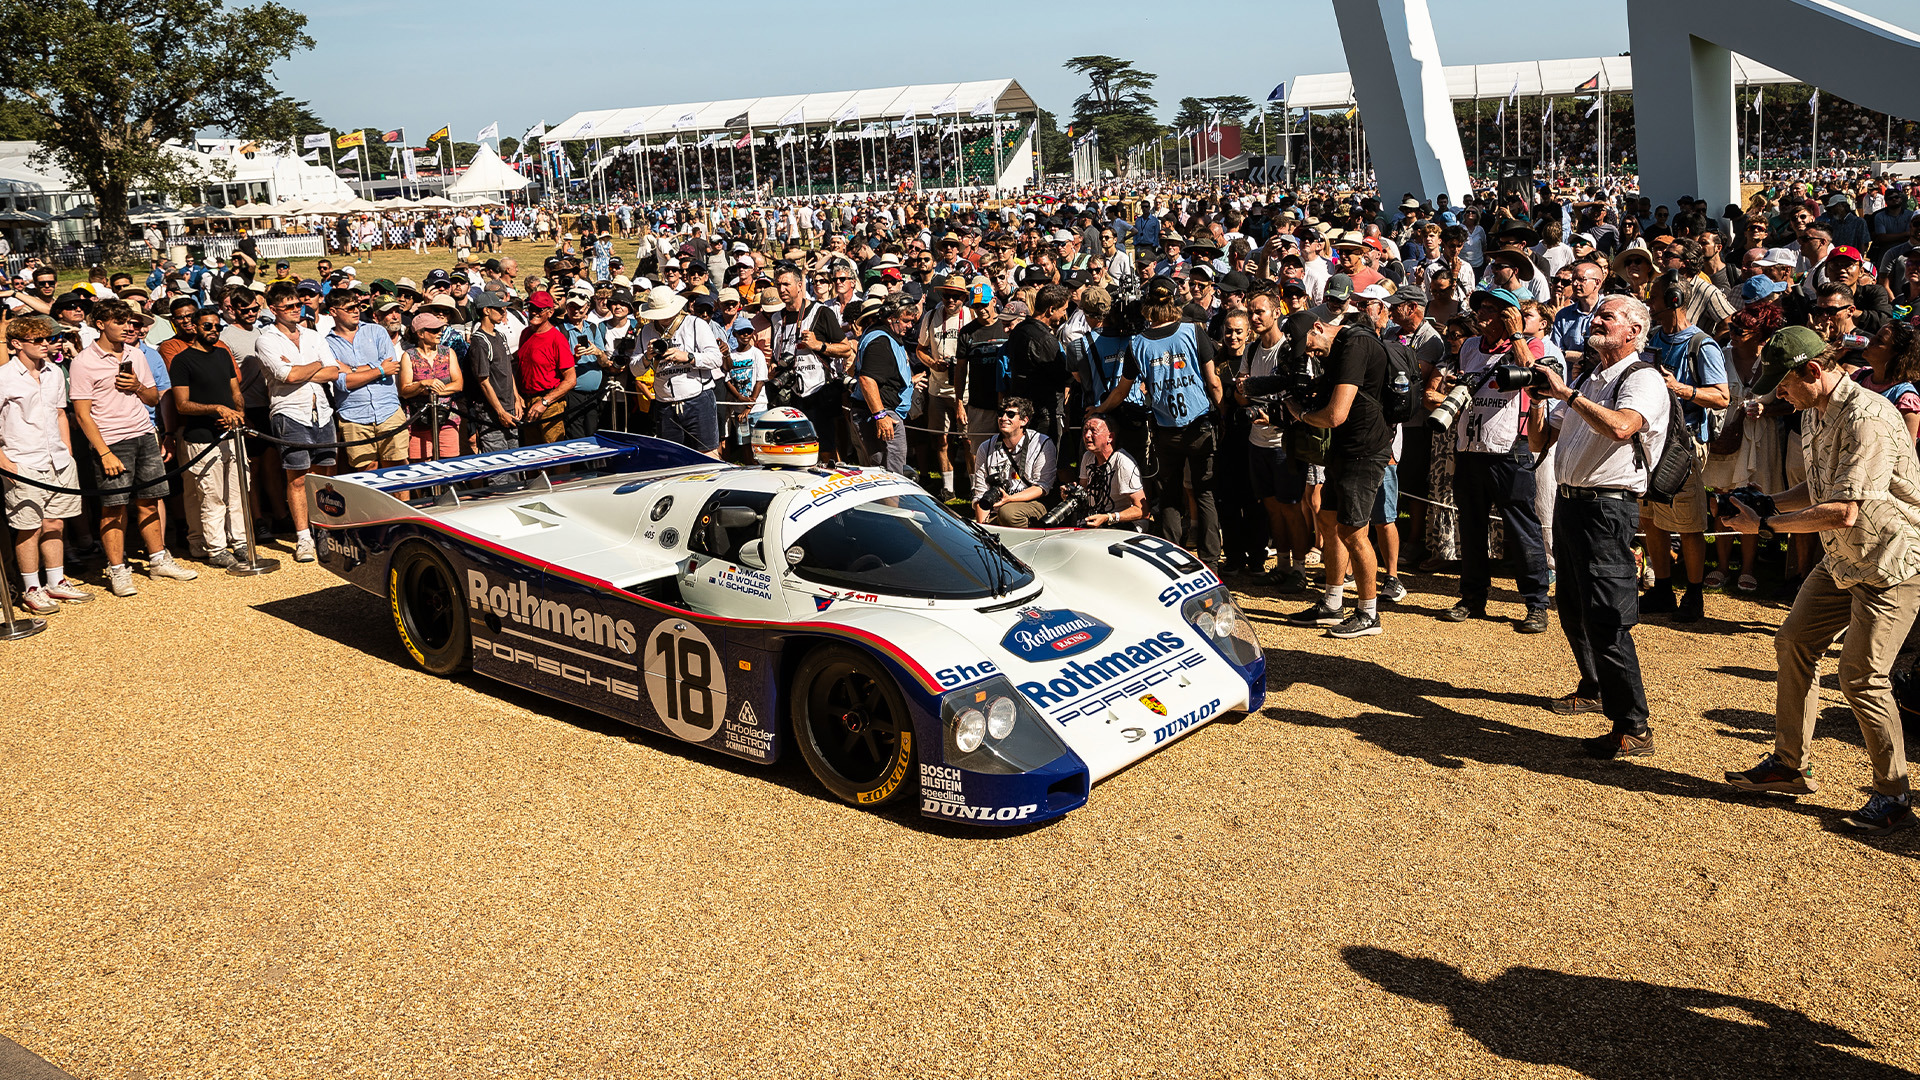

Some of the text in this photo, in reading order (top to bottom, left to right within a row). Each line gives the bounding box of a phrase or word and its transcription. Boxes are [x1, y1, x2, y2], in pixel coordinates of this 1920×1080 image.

[1164, 374, 1197, 391] TRACK
[1167, 392, 1188, 419] 68
[335, 440, 600, 488] Rothmans
[810, 473, 898, 499] AUTOGLASS
[643, 530, 655, 540] 405
[662, 531, 676, 544] 190
[327, 537, 359, 561] Shell
[1107, 535, 1204, 581] 18
[727, 573, 770, 591] B. WOLLEK
[745, 570, 771, 583] MASS
[725, 581, 772, 600] SCHUPPAN
[1158, 570, 1218, 608] Shell
[467, 569, 637, 654] Rothmans
[1014, 614, 1096, 652] Rothmans
[1057, 632, 1088, 650] RACING
[473, 635, 639, 700] PORSCHE
[1016, 631, 1185, 709] Rothmans
[656, 631, 714, 730] 18
[1055, 652, 1207, 728] PORSCHE
[725, 719, 776, 741] Turbolader
[1154, 698, 1221, 744] DUNLOP
[725, 730, 771, 751] TELETRON
[863, 746, 909, 803] DUNLOP
[920, 763, 961, 781] BOSCH
[921, 775, 962, 793] BILSTEIN
[921, 787, 966, 803] speedline
[921, 799, 1037, 822] DUNLOP
